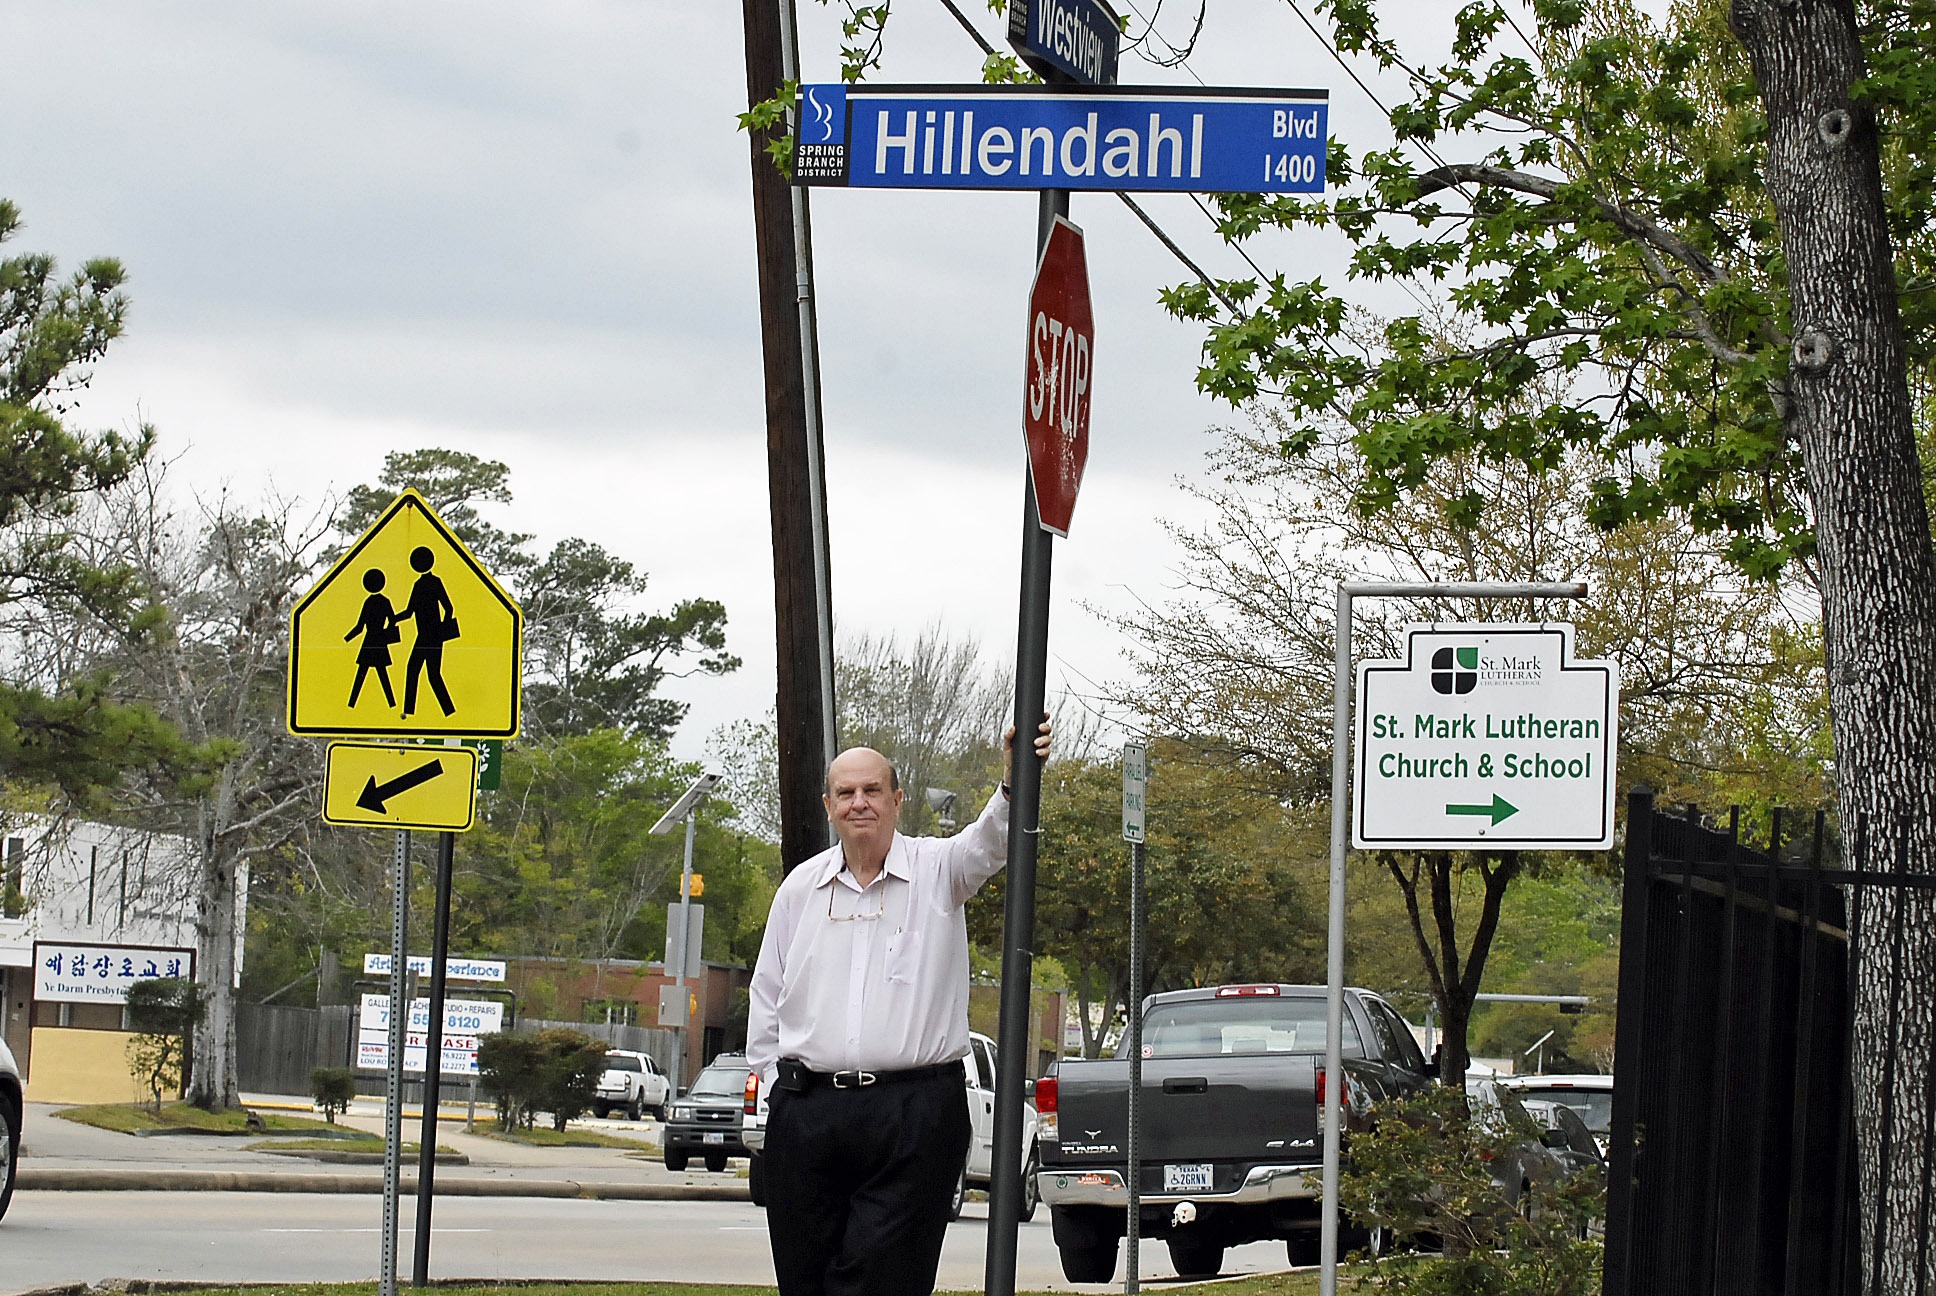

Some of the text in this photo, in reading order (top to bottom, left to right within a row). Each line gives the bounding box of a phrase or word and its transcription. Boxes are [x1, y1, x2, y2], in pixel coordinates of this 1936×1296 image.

[1038, 0, 1104, 85] Westview
[799, 145, 844, 156] SPRING
[874, 109, 1318, 179] Hillendahl Blvd
[798, 157, 844, 168] BRANCH
[1264, 153, 1316, 184] 1400
[797, 168, 843, 177] DISTRICT
[1030, 310, 1089, 438] STOP
[1480, 655, 1541, 670] St. Mark
[1481, 671, 1541, 680] LUTHERAN
[1372, 713, 1600, 739] St. Mark Lutheran
[1379, 752, 1591, 778] Church & School
[45, 982, 55, 992] Ye
[57, 983, 83, 993] Darm
[469, 1006, 496, 1015] REPAIRS
[1061, 1145, 1119, 1154] TUNDRA
